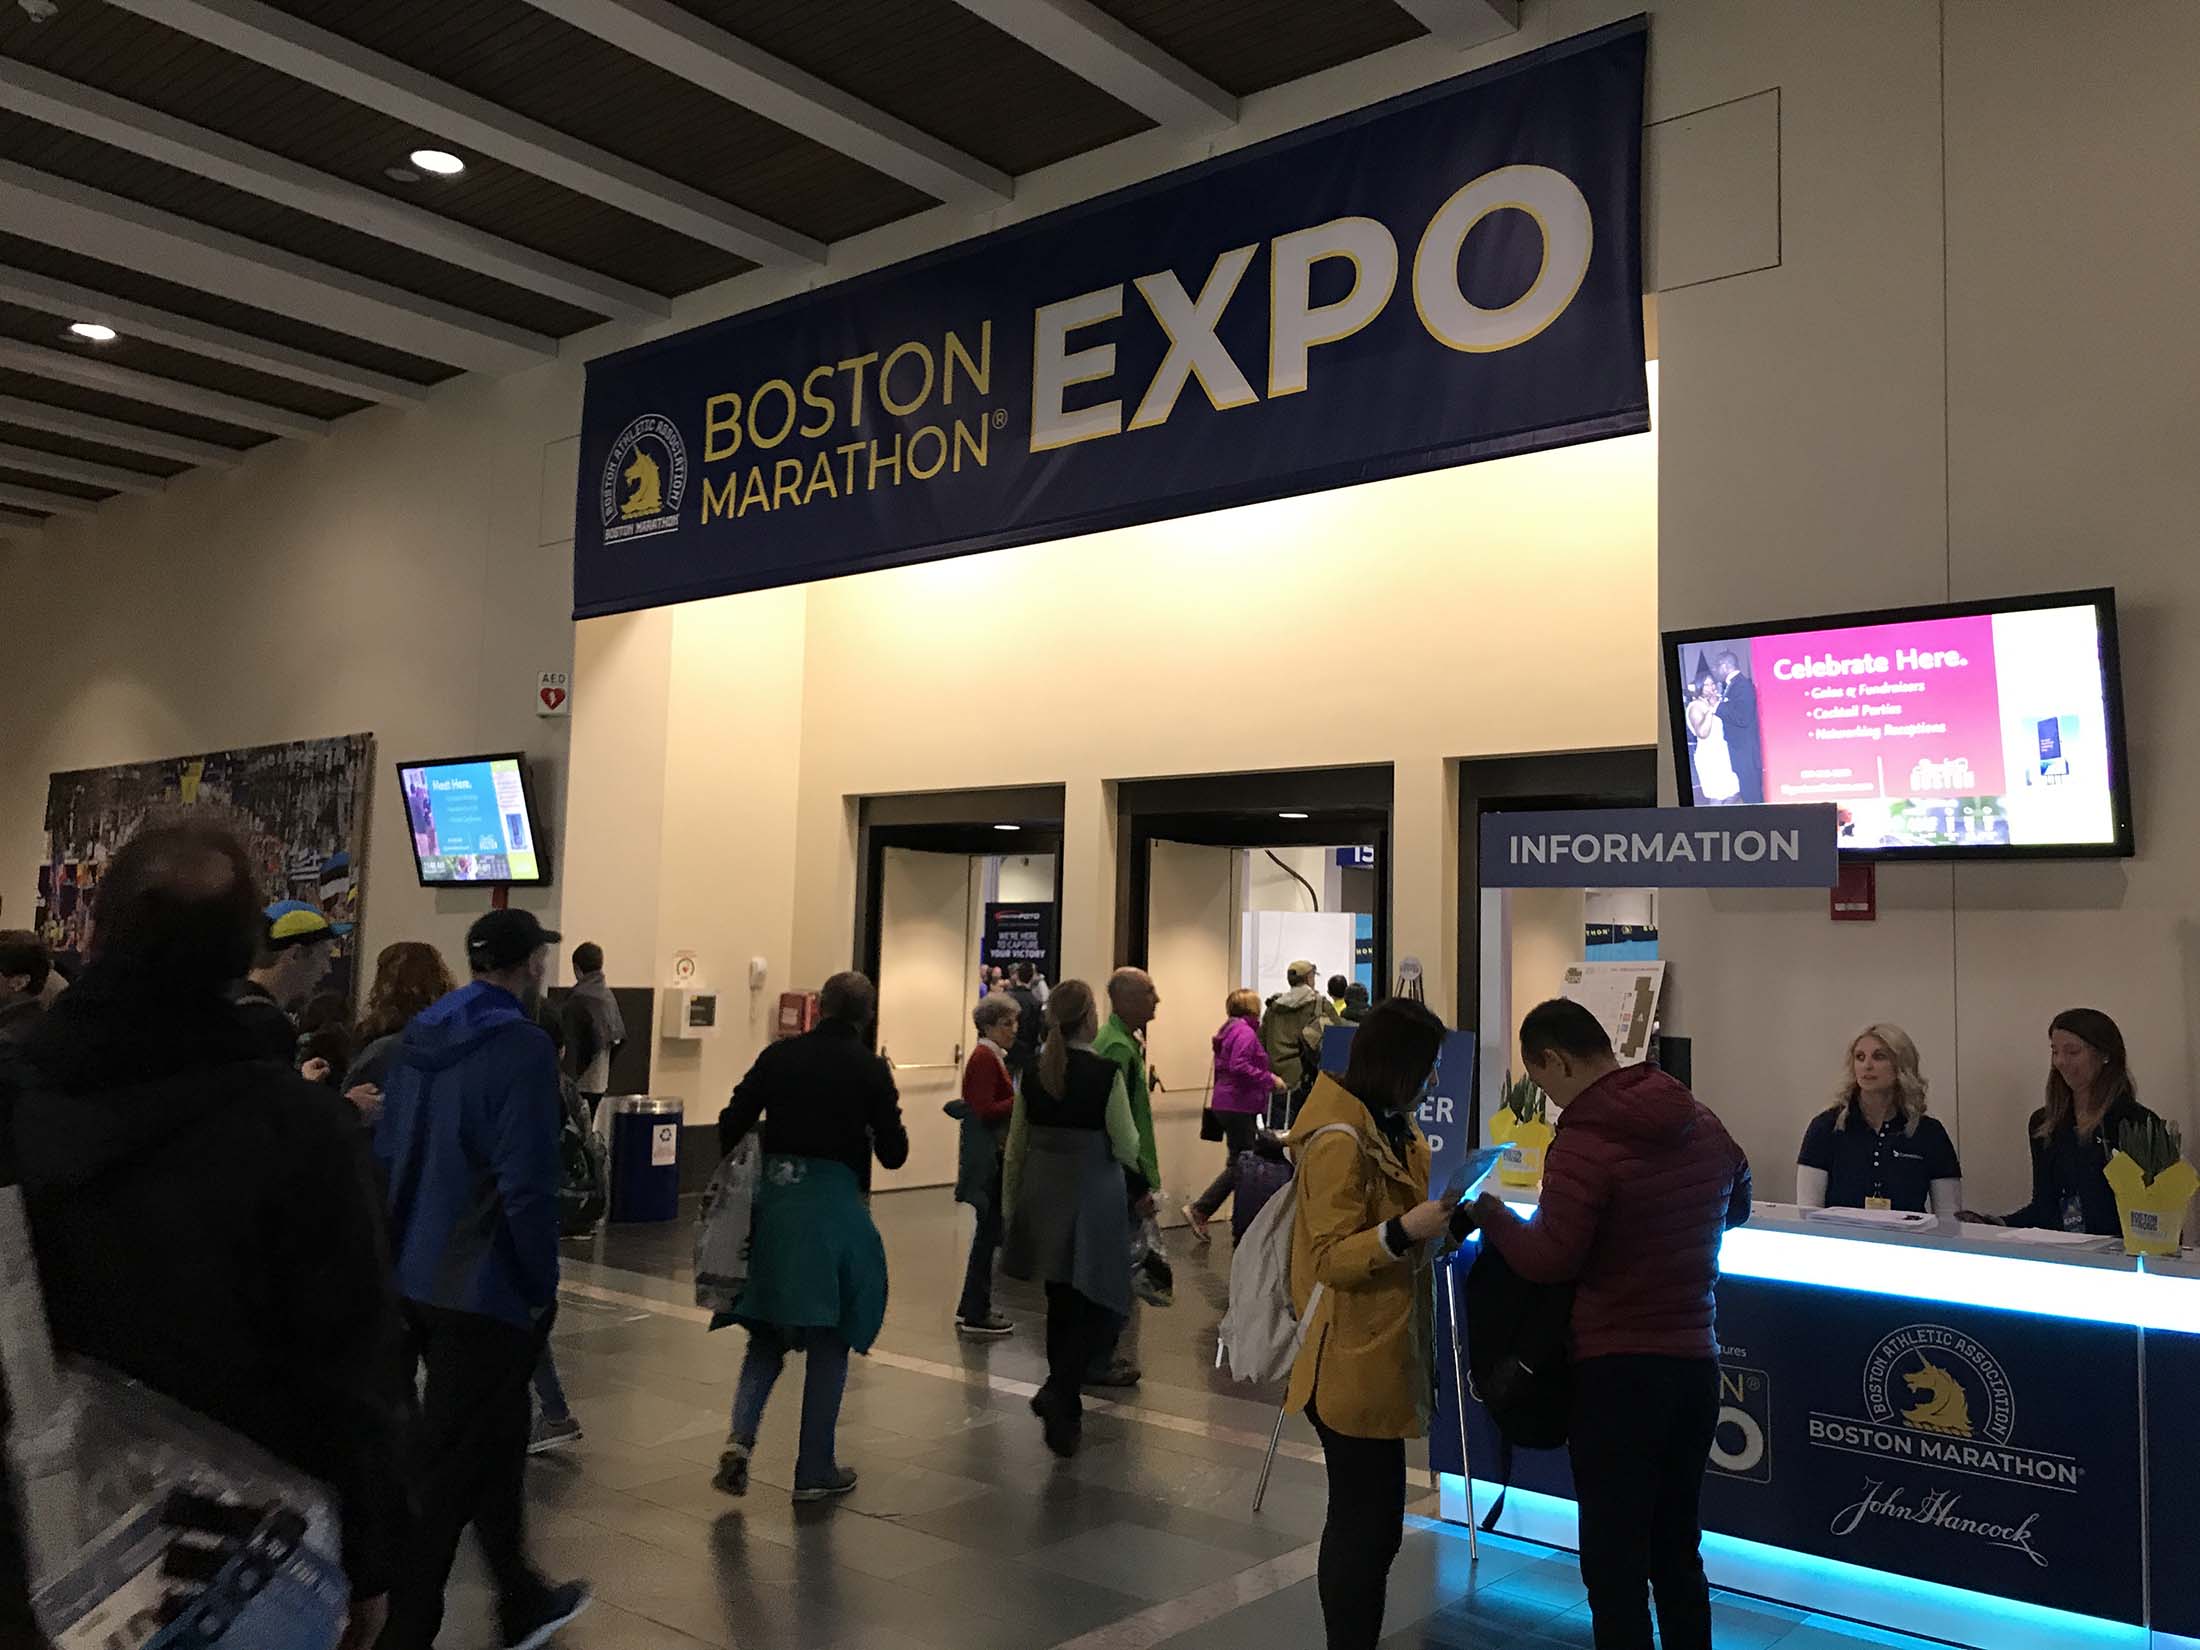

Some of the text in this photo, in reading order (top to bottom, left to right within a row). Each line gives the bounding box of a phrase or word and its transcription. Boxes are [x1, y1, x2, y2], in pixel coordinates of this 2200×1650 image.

[1030, 164, 1594, 453] EXPO
[704, 320, 992, 463] BOSTON
[604, 524, 634, 540] BOSTON
[542, 673, 566, 684] AED
[1773, 648, 1969, 681] Celebrate Here.
[1509, 829, 1799, 864] INFORMATION
[1868, 1329, 2010, 1436] BOSTON ATHLETIC ASSOCIATION
[1809, 1420, 2078, 1485] BOSTON MARATHON
[1830, 1475, 2049, 1568] John Hancock
